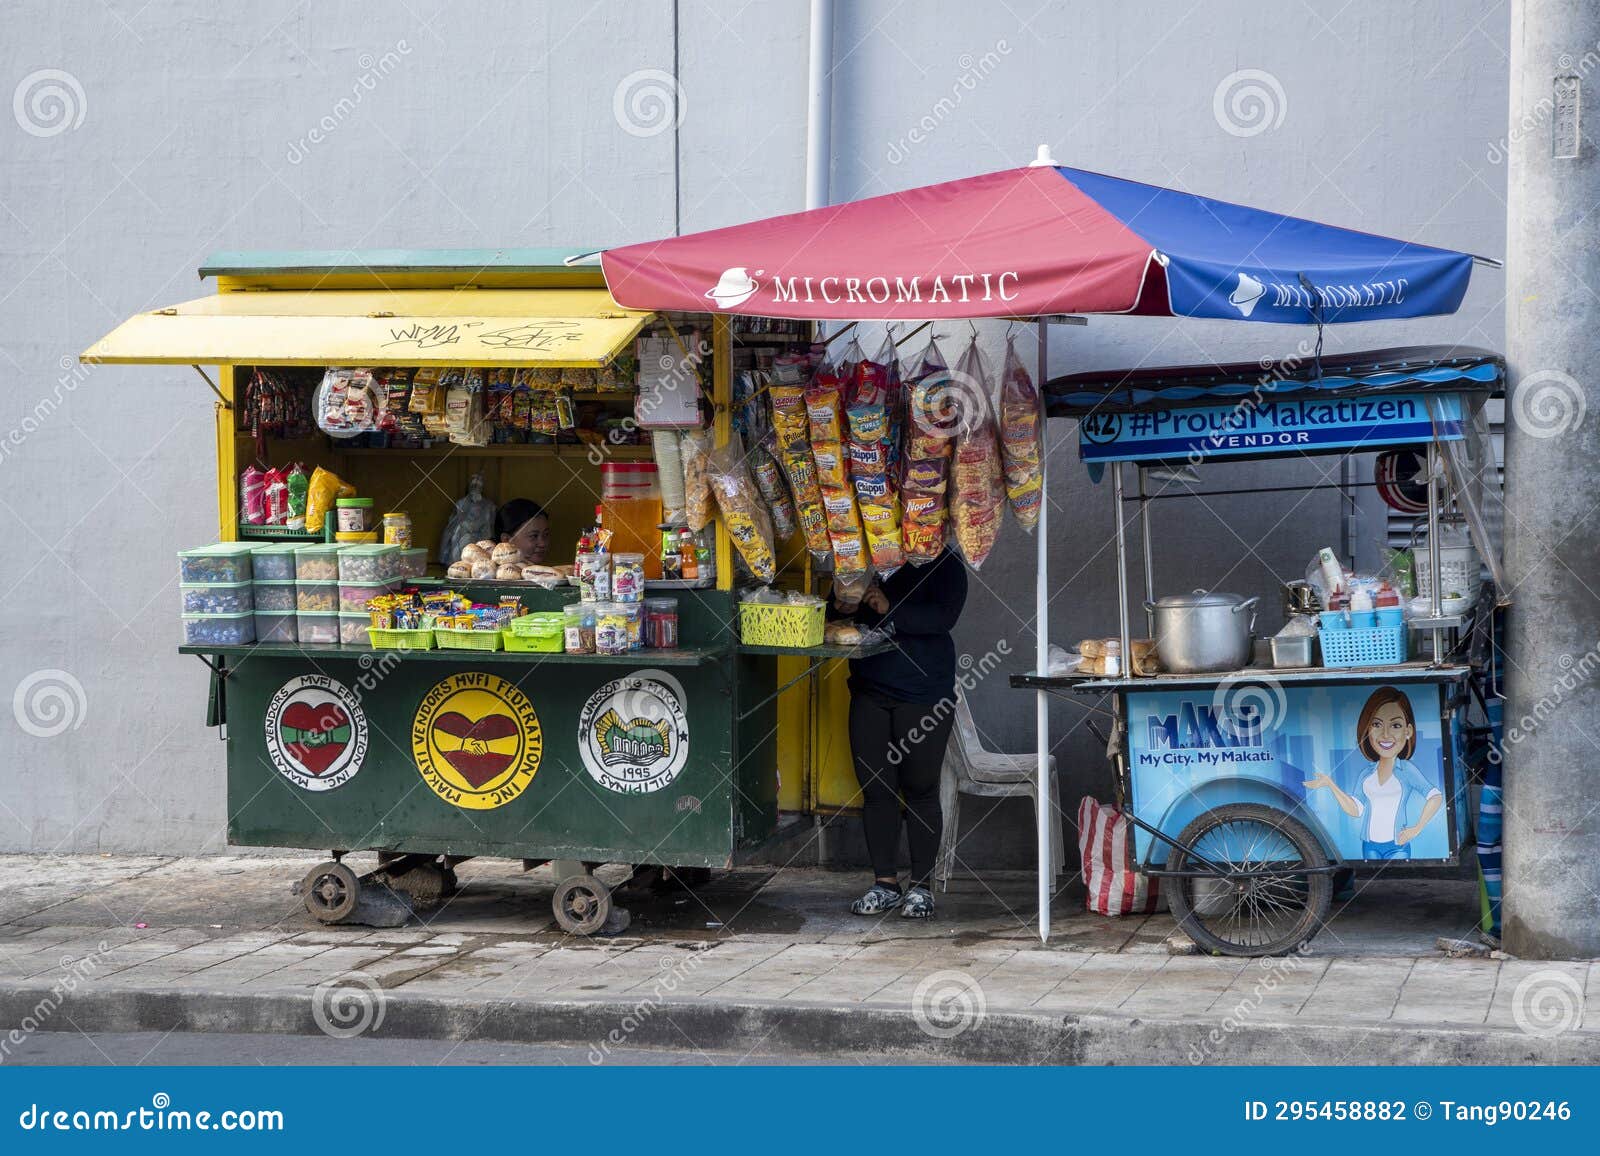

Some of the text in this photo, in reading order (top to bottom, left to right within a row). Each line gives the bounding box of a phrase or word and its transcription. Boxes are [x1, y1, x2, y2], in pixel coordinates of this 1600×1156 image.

[772, 272, 1019, 304] MICROMATIC
[1270, 278, 1409, 309] MICROMATIC
[1085, 415, 1114, 437] 42
[1213, 432, 1310, 448] VENDOR
[857, 481, 886, 496] Chippy
[906, 500, 936, 513] Nova
[455, 674, 490, 688] MVFI
[413, 680, 452, 744] VENDORS
[265, 676, 366, 788] MAKATI VENDORS MVFI FEDERATION INC.
[496, 679, 541, 777] FEDERATION
[1140, 749, 1274, 767] My City. My Makati.
[416, 751, 462, 803] MAKATI
[599, 769, 674, 793] PILIPINAS
[623, 768, 651, 779] 1995
